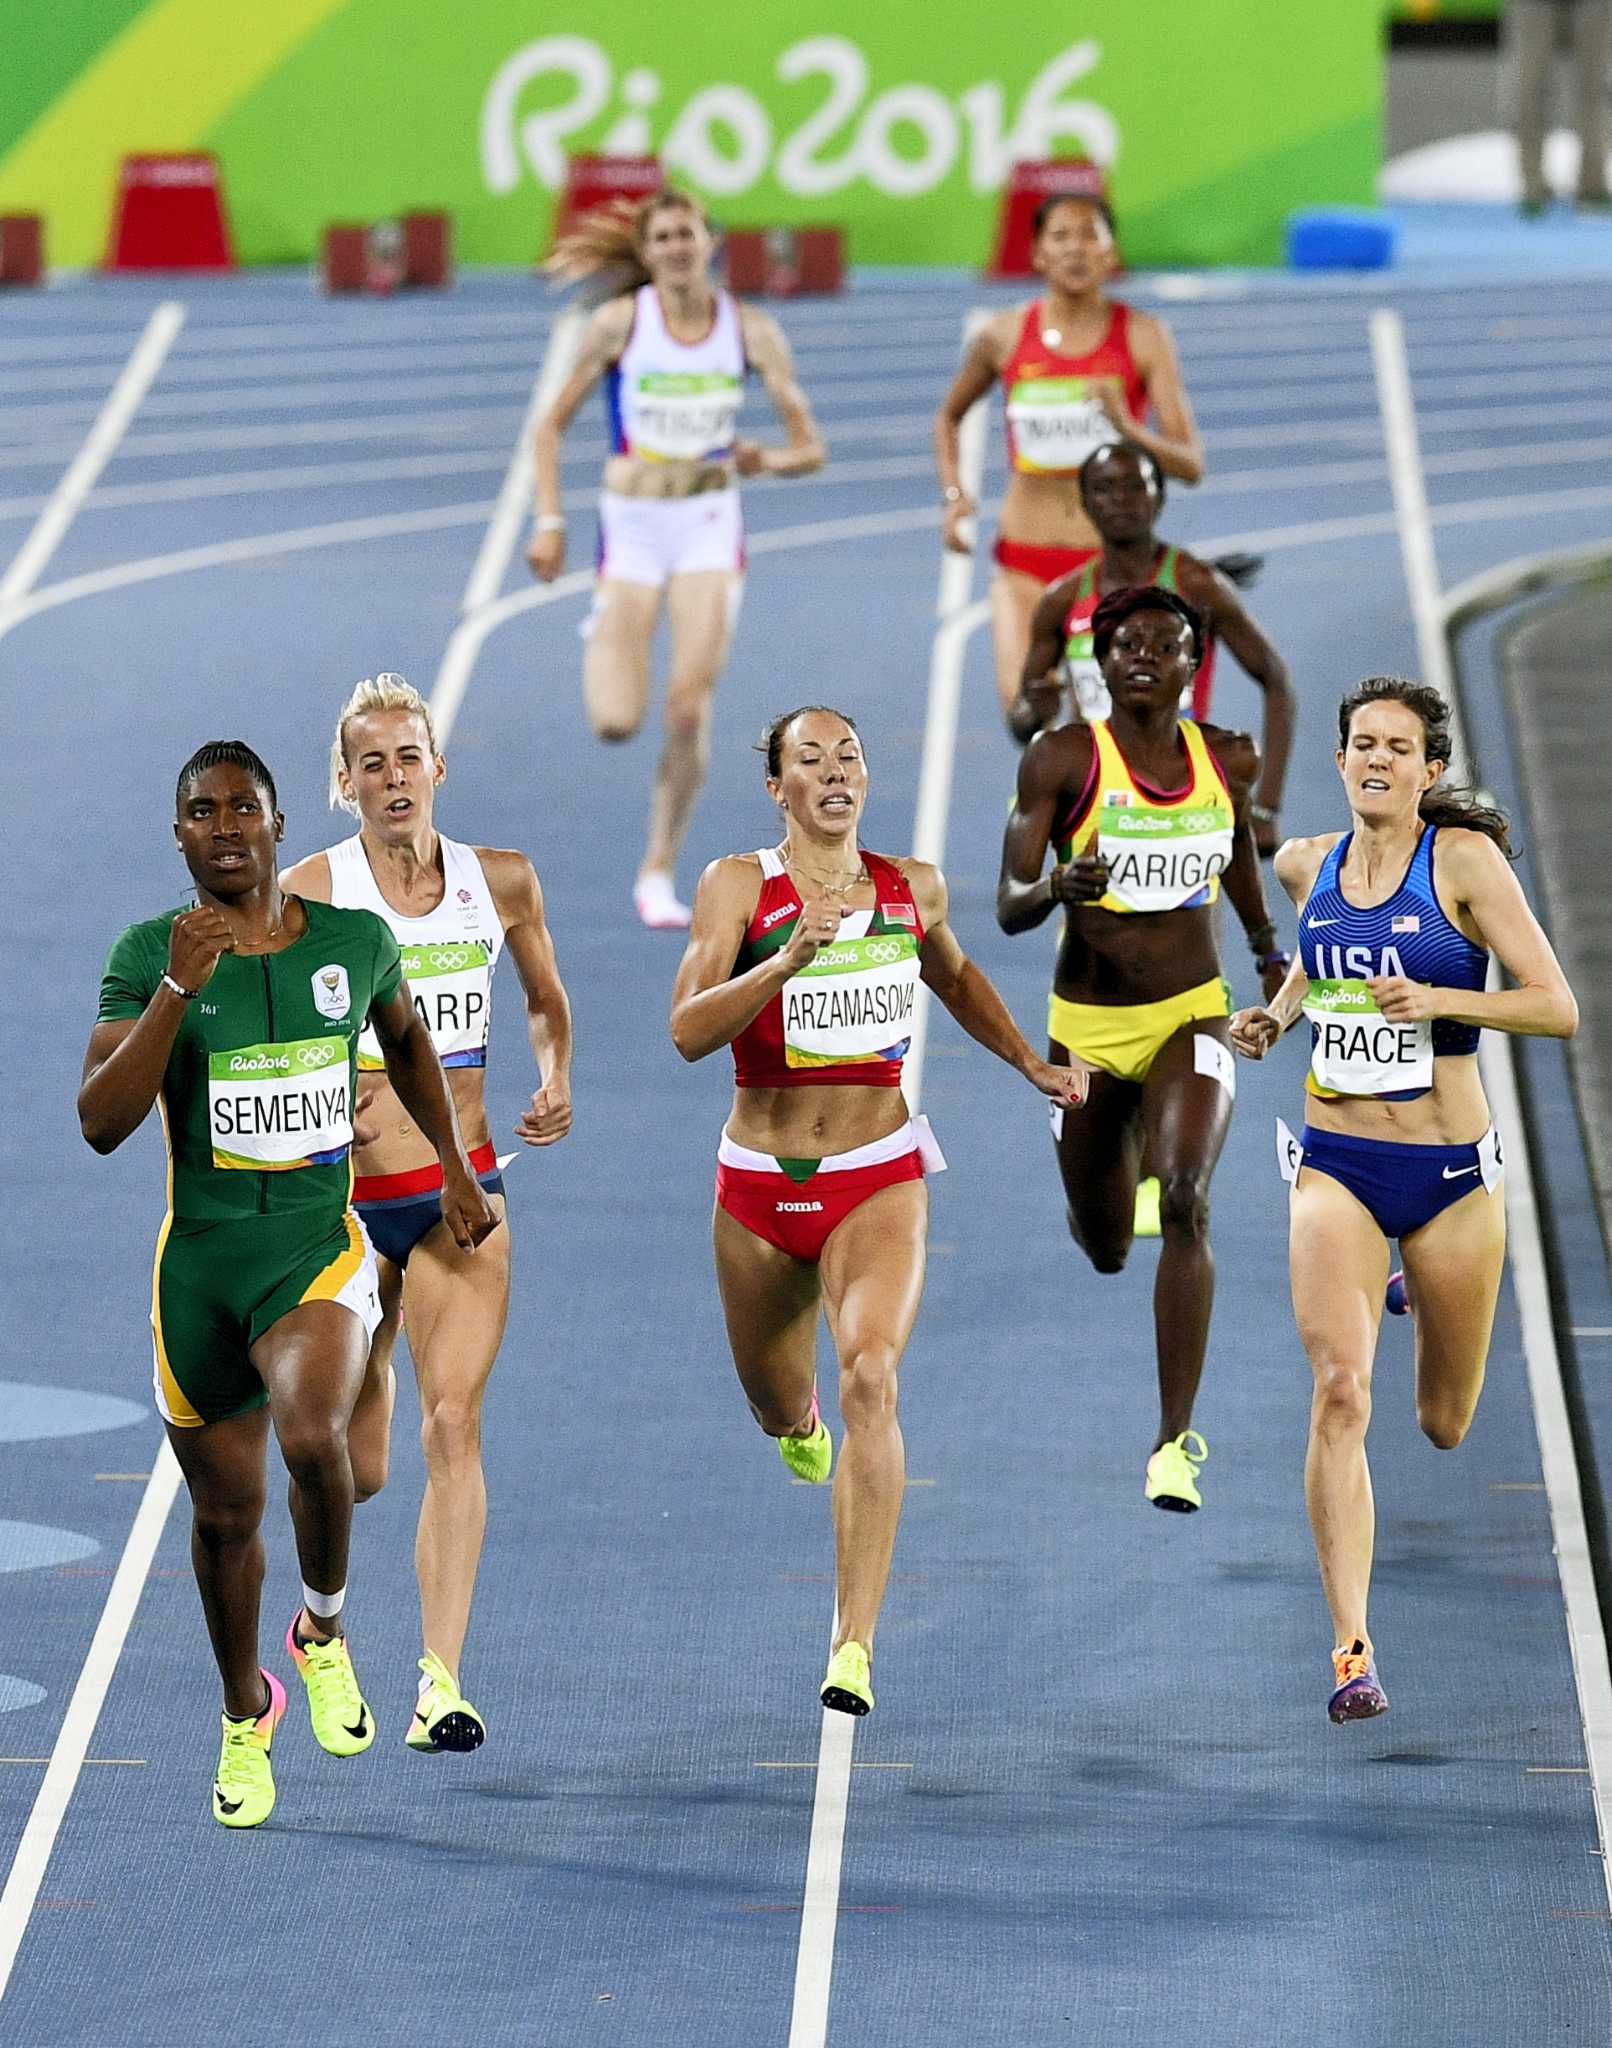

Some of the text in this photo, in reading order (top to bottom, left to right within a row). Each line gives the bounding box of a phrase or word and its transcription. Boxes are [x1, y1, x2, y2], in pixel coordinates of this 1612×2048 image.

[787, 982, 914, 1031] ARZAMASOVA
[230, 1053, 290, 1071] Rio2016
[1312, 1021, 1417, 1064] RACE
[214, 1086, 347, 1135] SEMENYA
